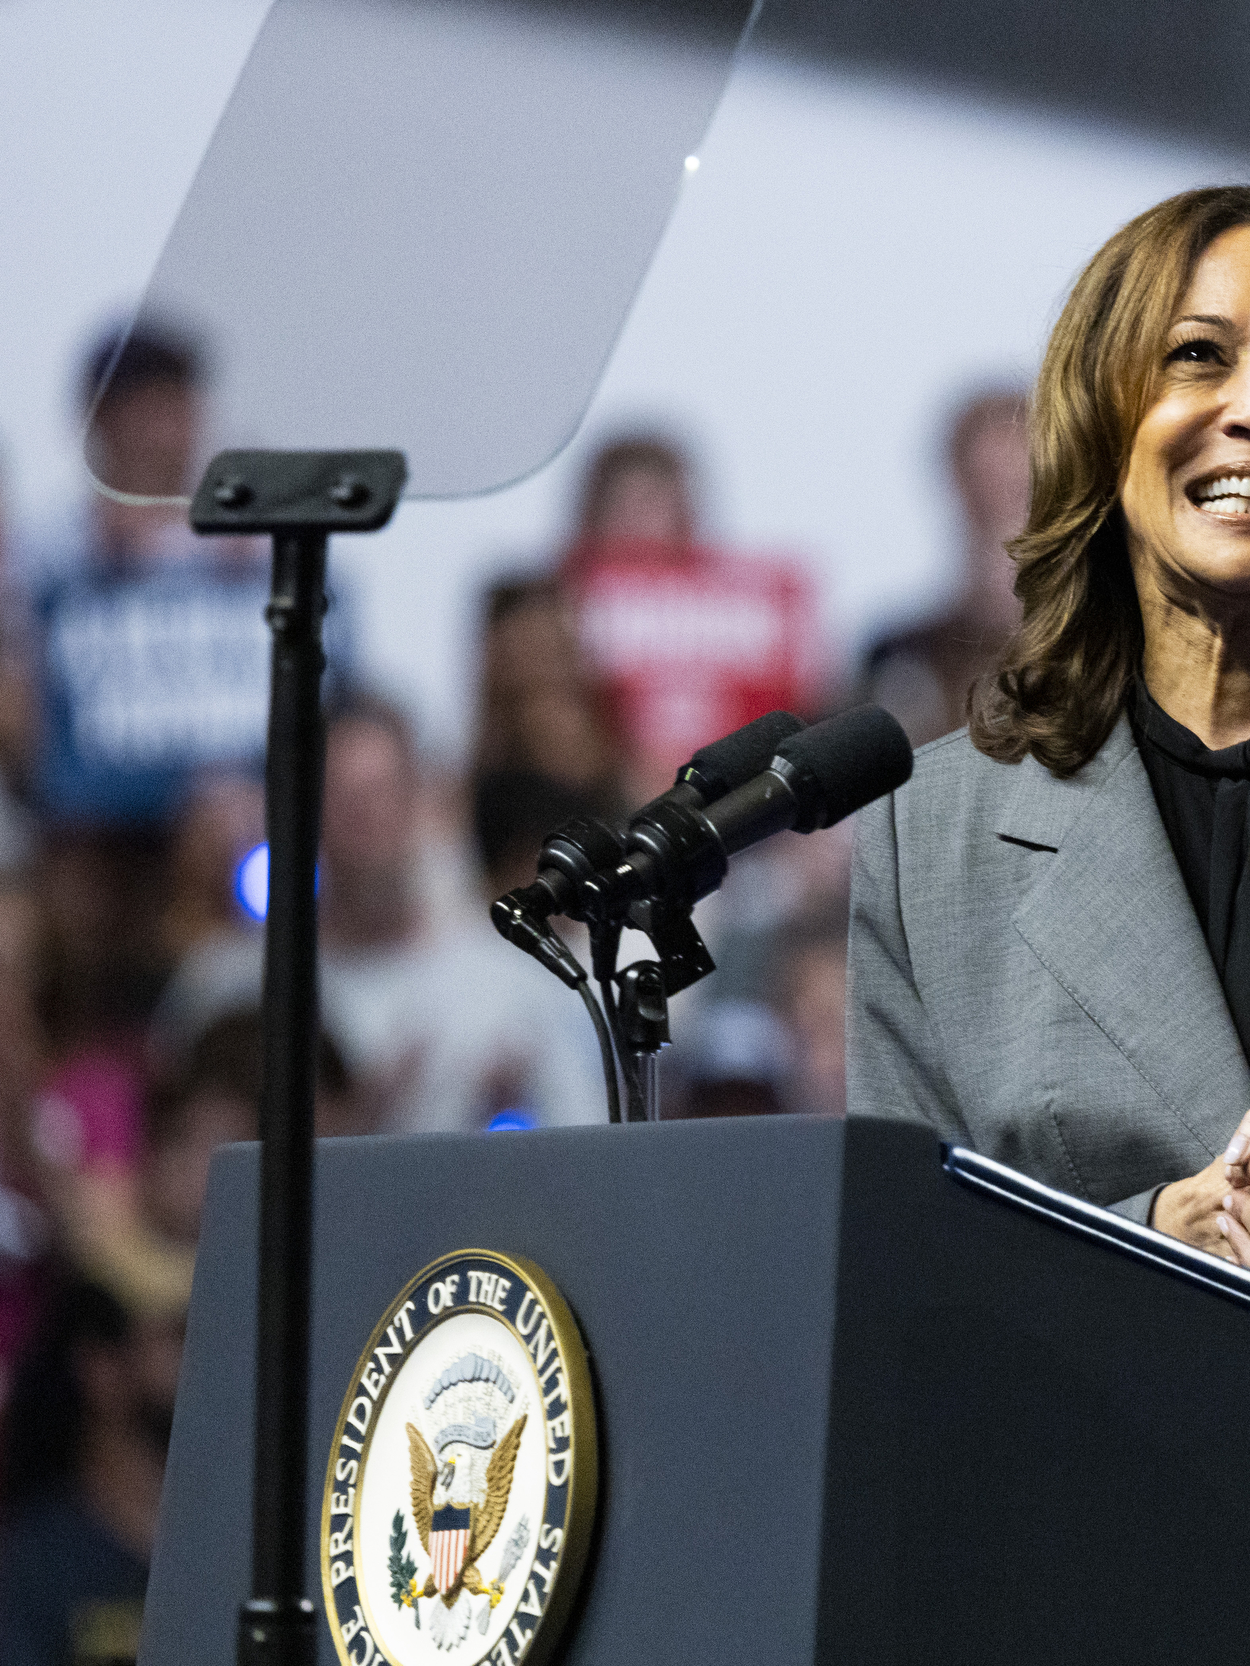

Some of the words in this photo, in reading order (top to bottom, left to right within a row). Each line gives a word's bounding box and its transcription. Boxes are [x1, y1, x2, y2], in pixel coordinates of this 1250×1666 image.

[427, 1274, 460, 1315] OF
[467, 1270, 511, 1311] THE
[515, 1290, 571, 1486] UNITED
[329, 1300, 416, 1588] PRESIDENT
[340, 1605, 386, 1666] CE
[482, 1523, 564, 1666] STATE
